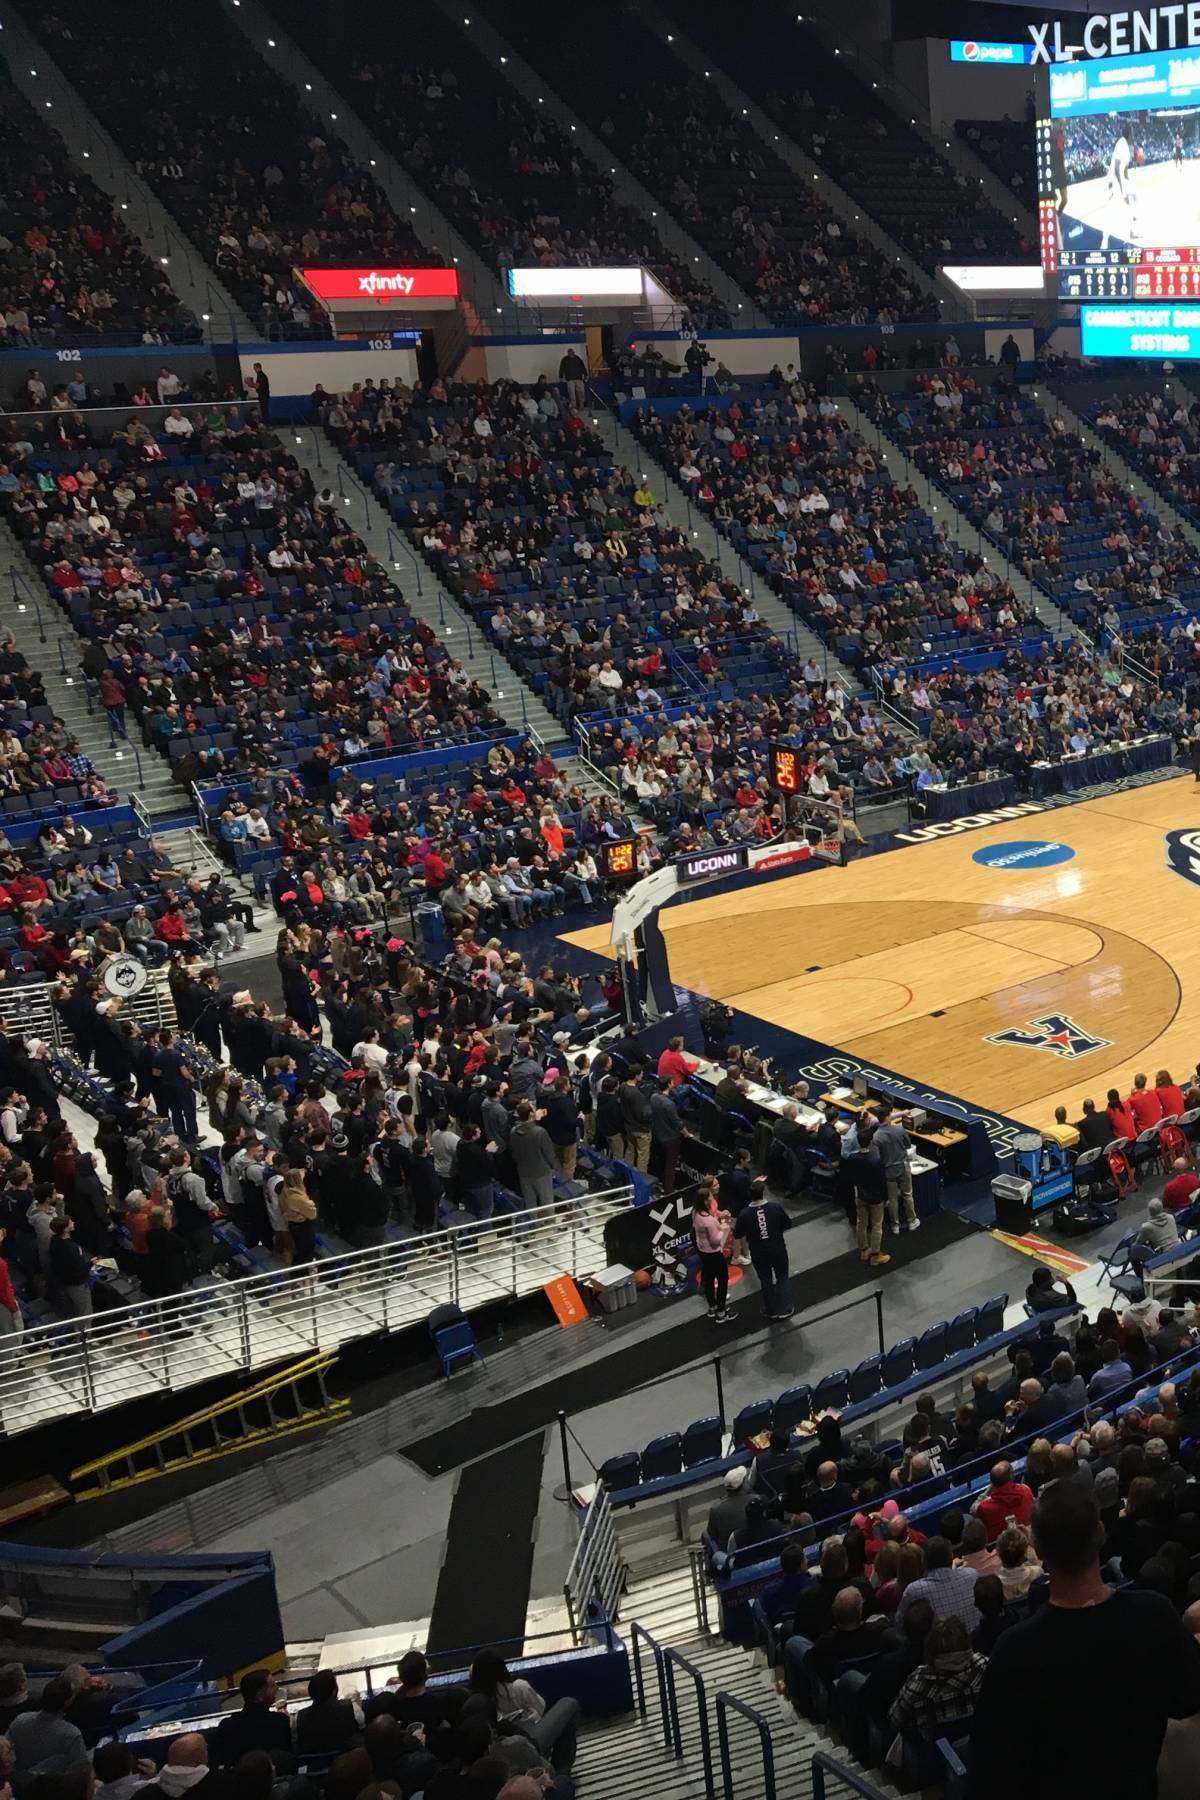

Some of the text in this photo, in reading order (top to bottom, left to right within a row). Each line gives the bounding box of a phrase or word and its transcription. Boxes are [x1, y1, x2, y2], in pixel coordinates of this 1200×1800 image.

[1028, 21, 1073, 64] XL
[981, 47, 1013, 59] pepsi
[358, 272, 414, 294] xfinity
[679, 331, 698, 340] 104
[880, 325, 894, 334] 105
[369, 340, 392, 349] 103
[1131, 334, 1190, 351] SYSTEMS
[56, 350, 81, 361] 102
[776, 752, 795, 764] 11:22
[777, 765, 794, 788] 25
[894, 765, 1192, 843] UCONN HUSKIES
[609, 845, 632, 856] 11:22
[612, 857, 628, 873] 25
[688, 853, 737, 876] UCONN
[650, 1198, 694, 1245] XL
[756, 1209, 769, 1240] UCONN
[664, 1231, 691, 1251] CENT
[929, 1456, 946, 1475] 15
